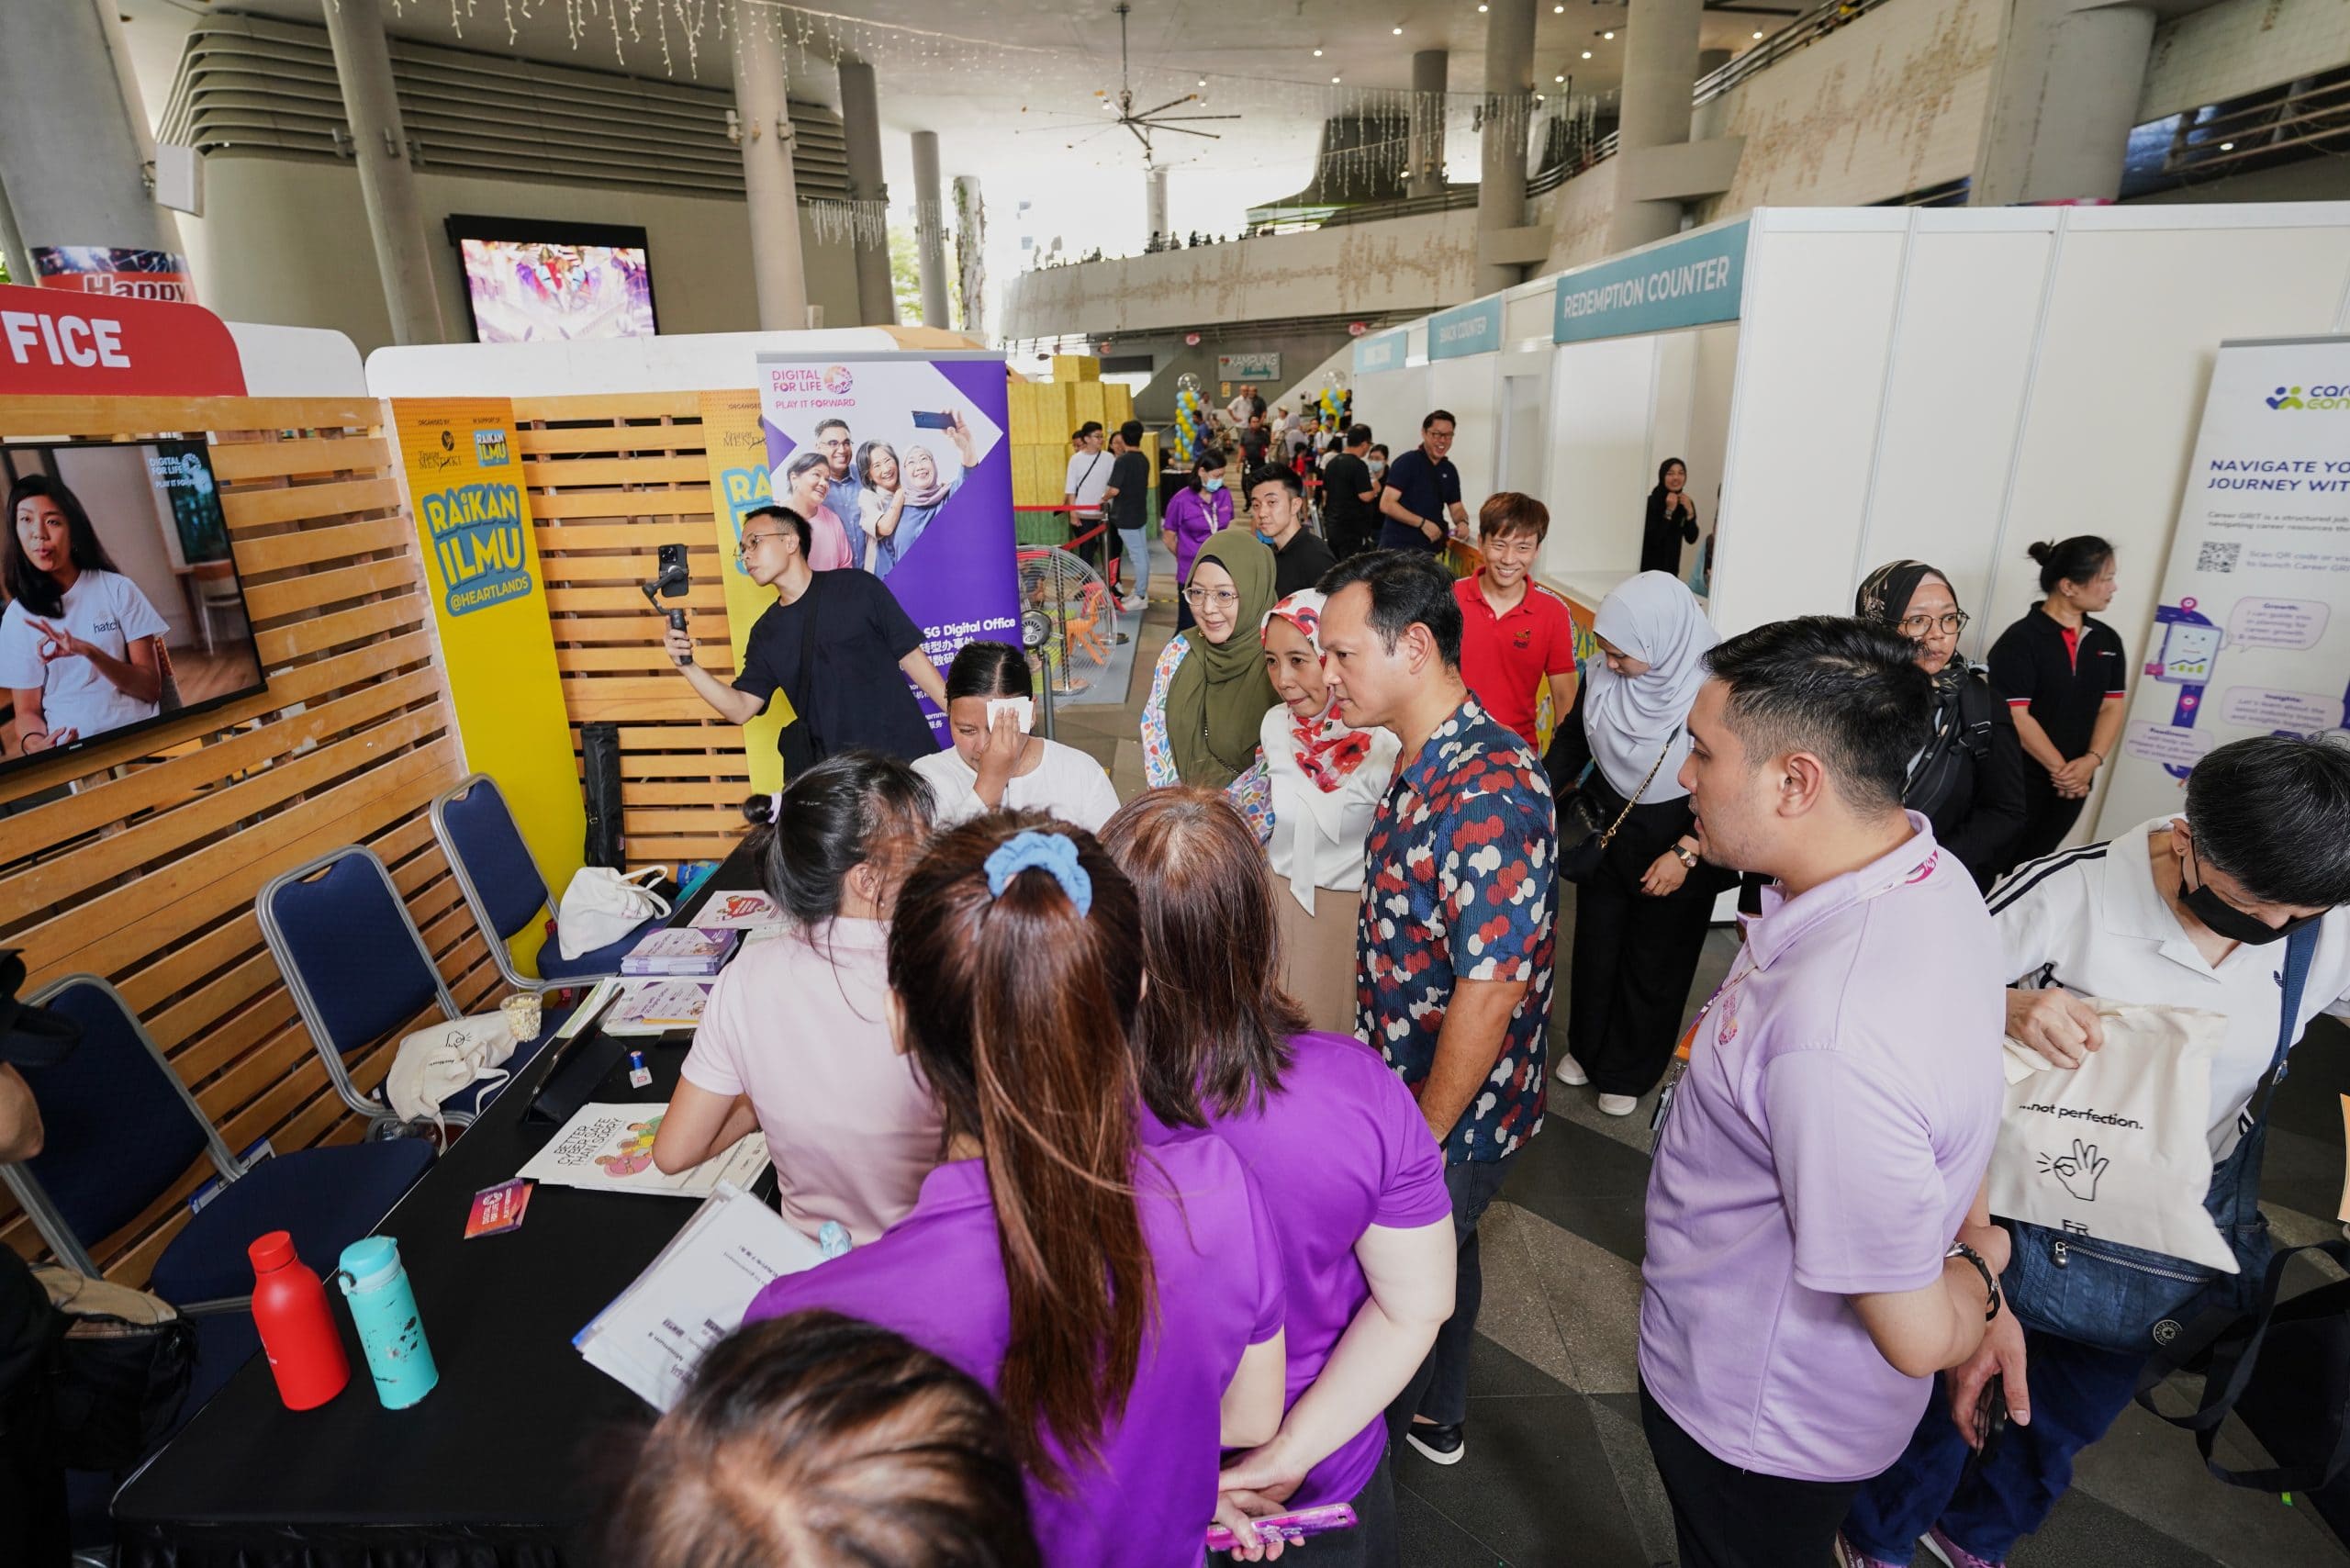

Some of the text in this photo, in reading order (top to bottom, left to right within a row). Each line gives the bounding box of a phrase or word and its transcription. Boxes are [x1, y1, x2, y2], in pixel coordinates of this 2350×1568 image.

[1564, 255, 1730, 318] REDEMPTION COUNTER
[1459, 316, 1487, 339] COUNTER
[772, 369, 821, 381] DIGITAL
[774, 381, 822, 392] FOR LIFE
[2310, 385, 2350, 398] car
[776, 398, 856, 409] PLAY IT FORWARD
[149, 456, 181, 467] DIGITAL
[479, 442, 507, 461] ILMU
[151, 465, 183, 475] FOR LIFE
[2210, 460, 2350, 473] NAVIGATE YO
[727, 471, 772, 502] RA
[2207, 477, 2350, 492] JOURNEY WIT
[439, 527, 522, 586] ILMU
[451, 576, 529, 611] @HEARTLANDS
[923, 617, 1015, 639] SG Digital Office
[2019, 1103, 2144, 1130] ...not perfection.
[554, 1126, 587, 1154] BETTER
[557, 1117, 611, 1164] CYBER SAFE
[567, 1117, 622, 1166] THAN SORRY
